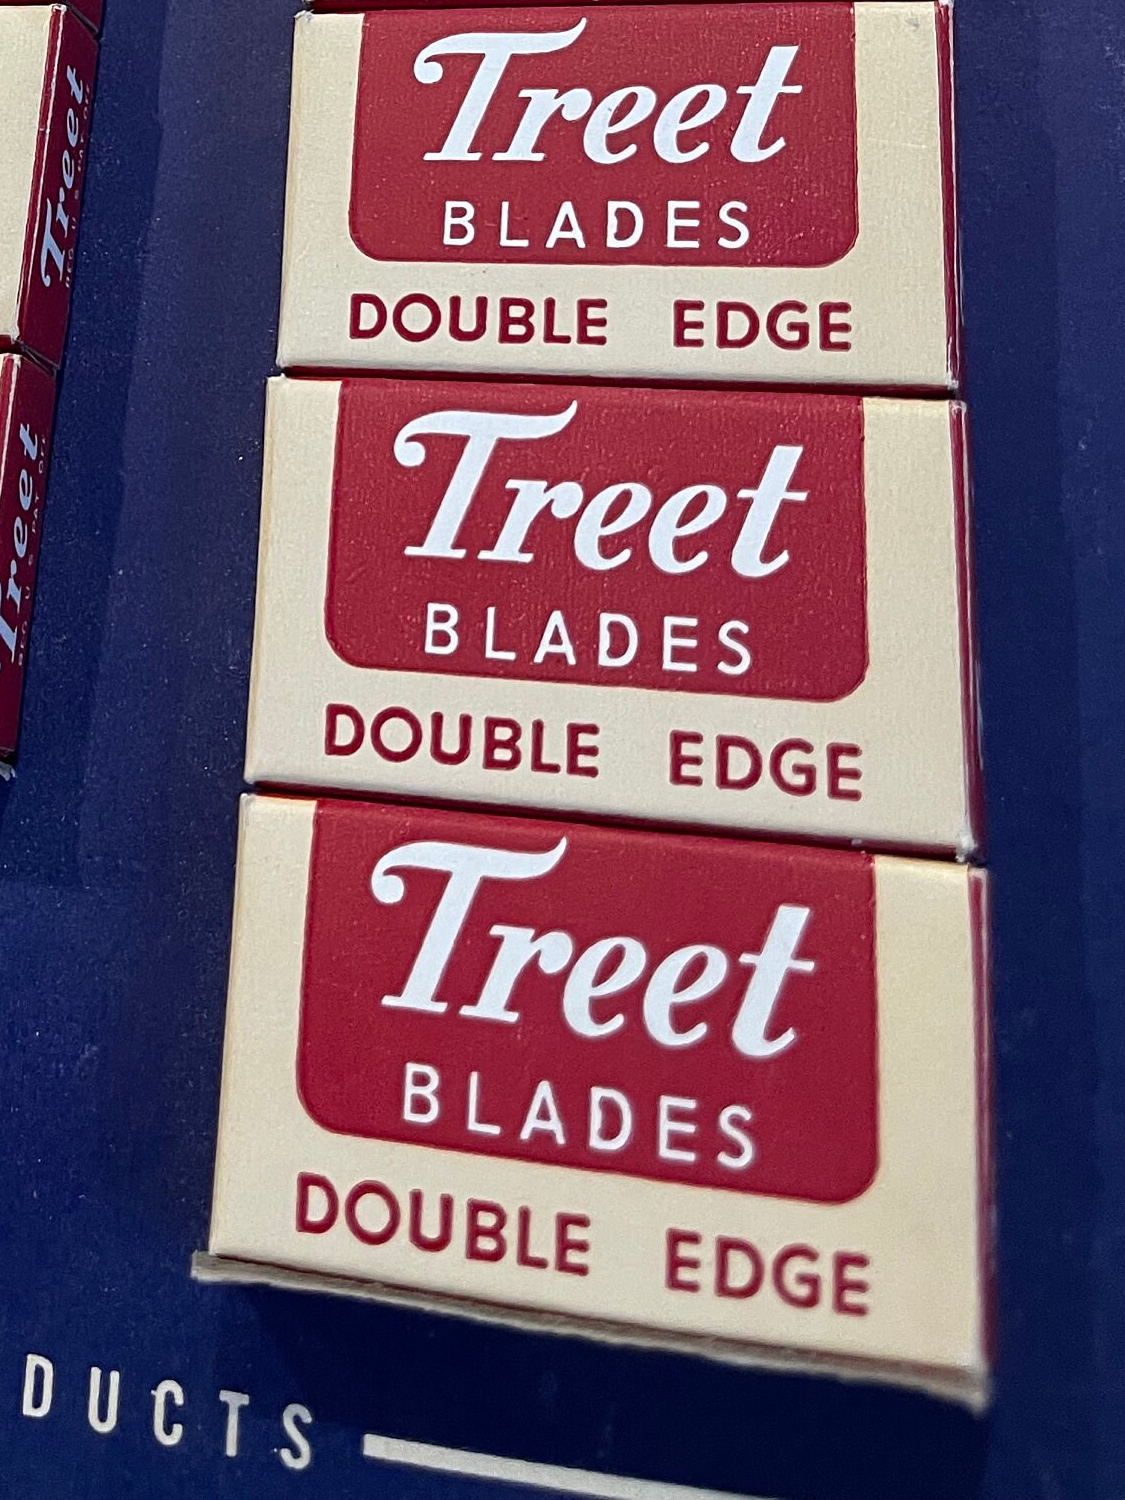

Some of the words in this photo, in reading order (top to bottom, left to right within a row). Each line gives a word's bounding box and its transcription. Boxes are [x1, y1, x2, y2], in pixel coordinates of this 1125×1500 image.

[414, 18, 802, 164] Treet
[41, 66, 83, 286] Treet
[443, 201, 749, 248] BLADES
[350, 293, 607, 345] DOUBLE
[674, 300, 851, 351] EDGE
[394, 400, 807, 577] Treet
[425, 603, 750, 675] BLADES
[325, 704, 599, 778] DOUBLE
[670, 730, 862, 801] EDGE
[371, 837, 815, 1057] Treet
[403, 1062, 754, 1169] BLADES
[296, 1172, 590, 1276] DOUBLE
[666, 1228, 869, 1316] EDGE
